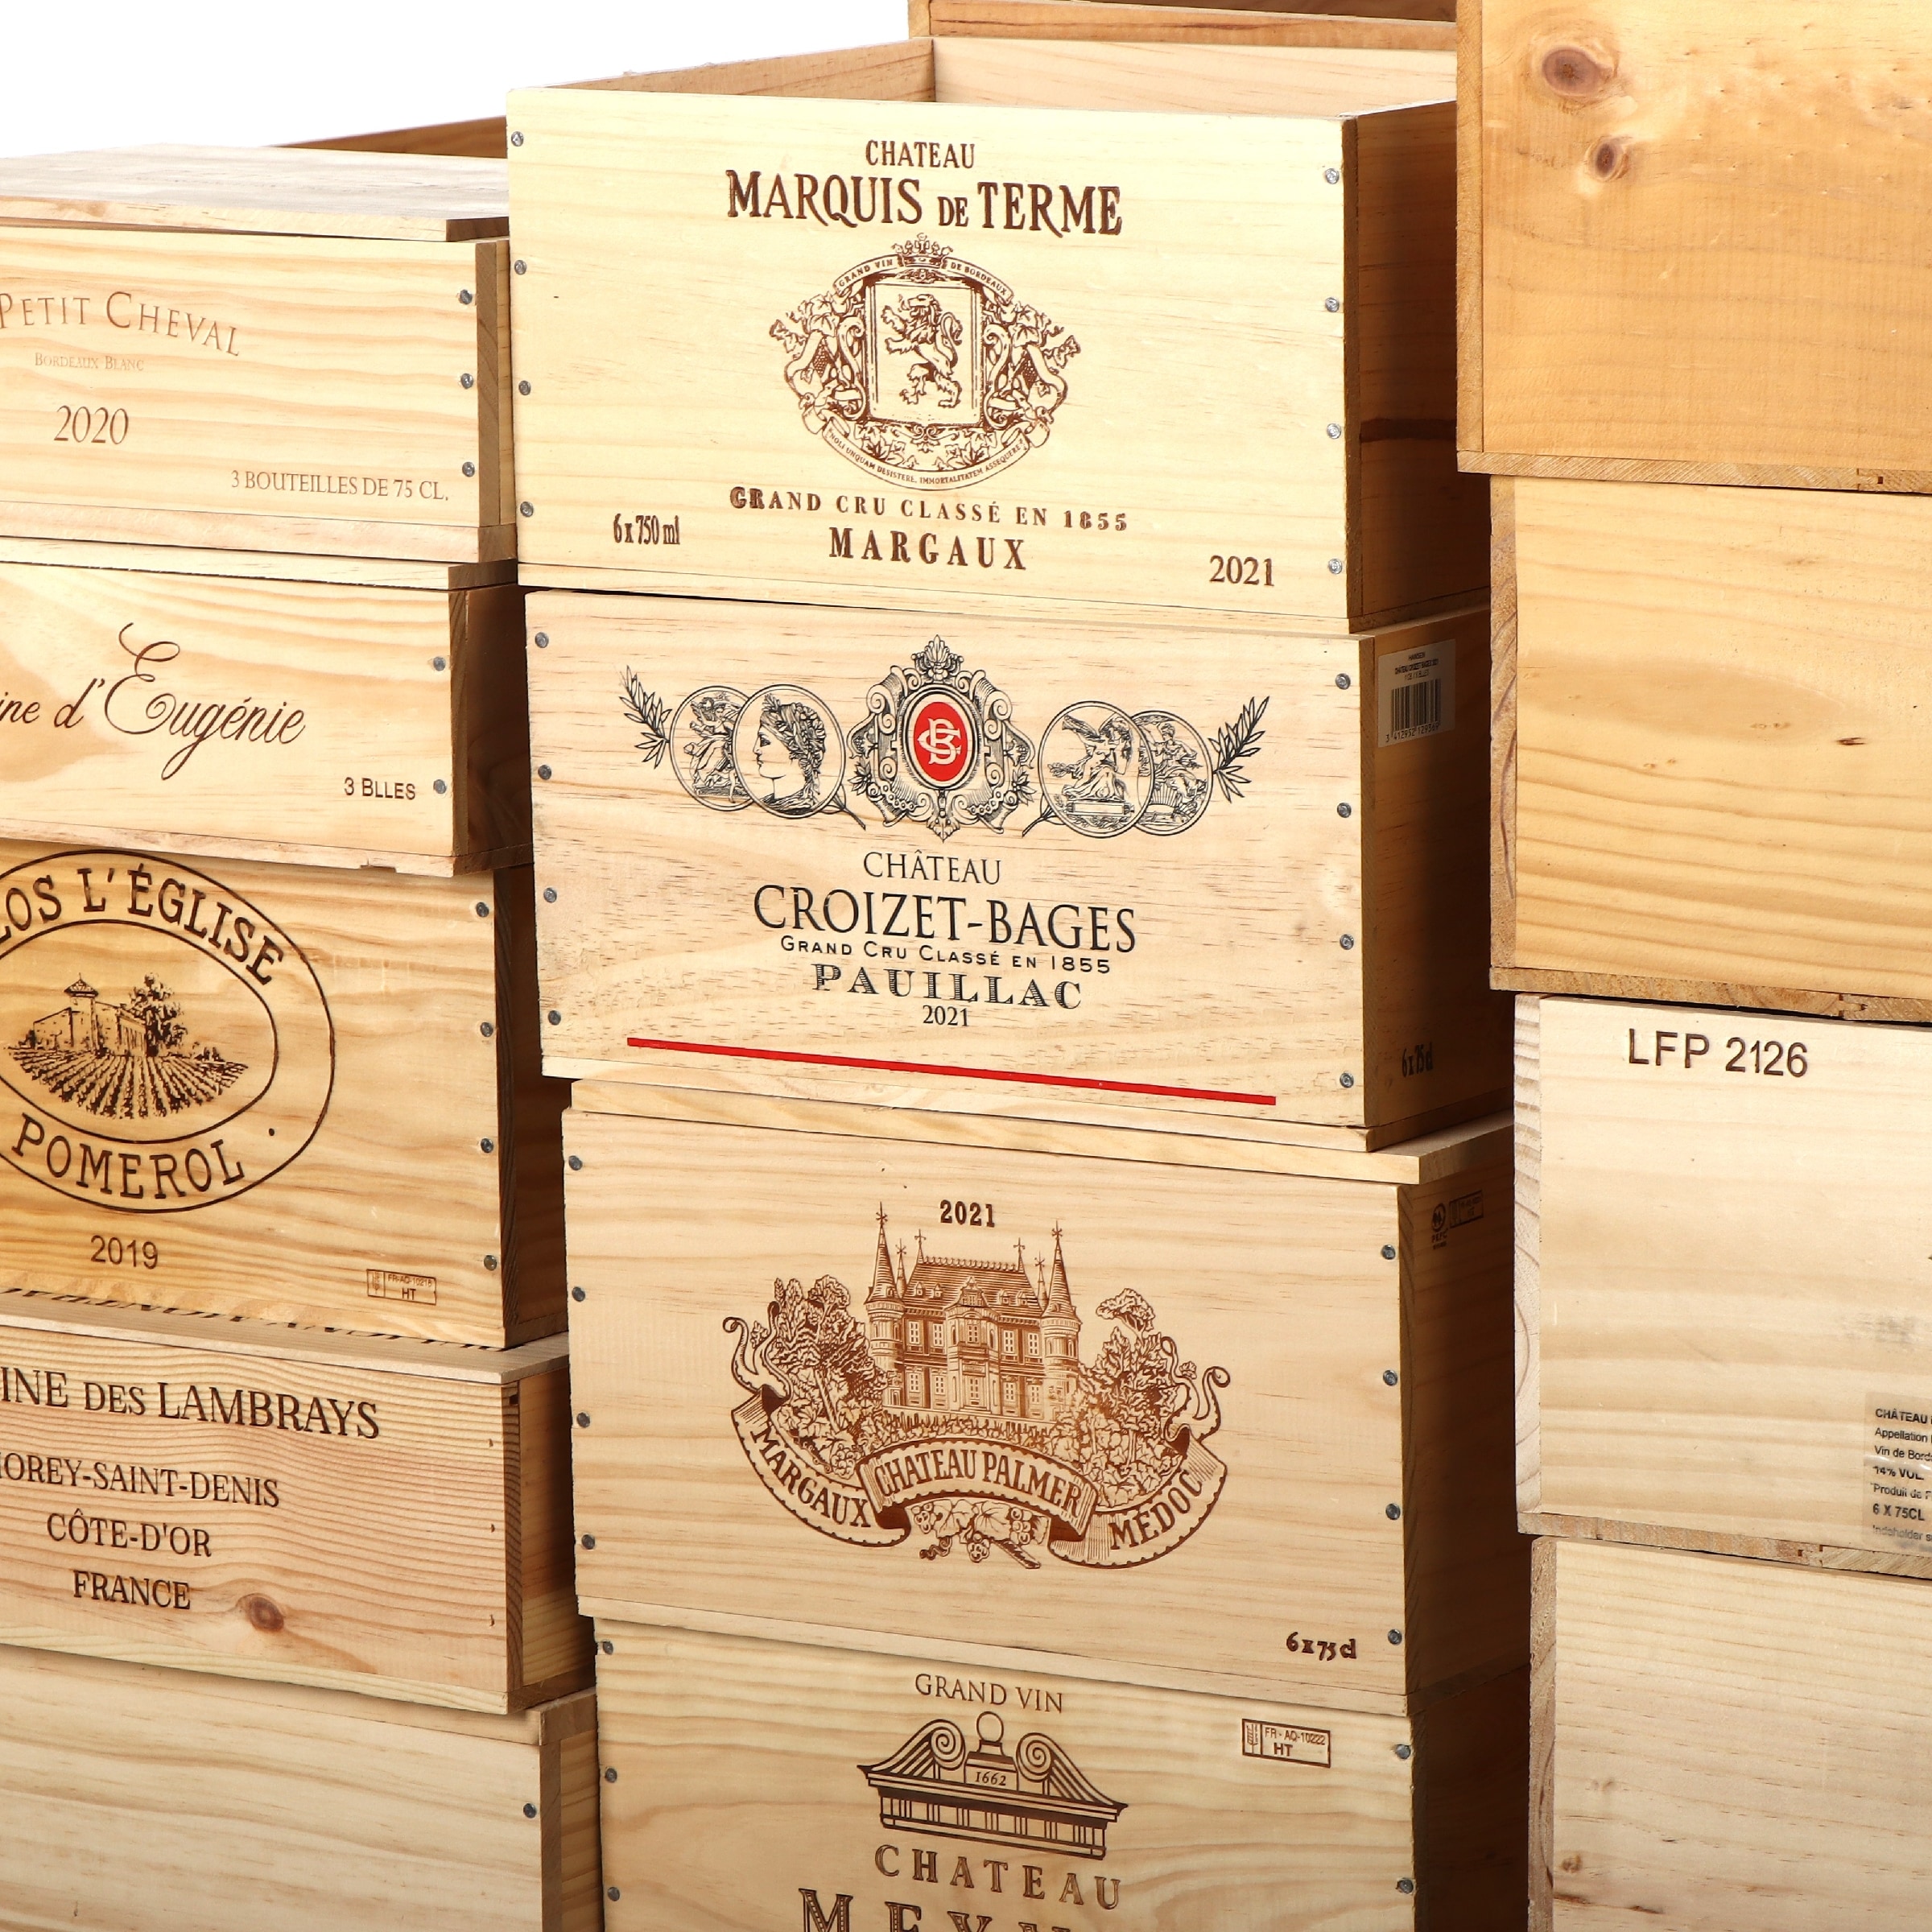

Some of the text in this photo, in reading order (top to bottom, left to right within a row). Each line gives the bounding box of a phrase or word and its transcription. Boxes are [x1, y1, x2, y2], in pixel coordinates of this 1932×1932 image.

[865, 139, 976, 169] CHATEAU
[725, 170, 1123, 238] MARQUIS DE TERME
[839, 258, 1008, 296] GRAND VIN DE BORDEAUX
[0, 291, 239, 357] PETIT CHEVAL
[35, 352, 144, 371] BORDEAUX BLANC
[53, 405, 129, 444] 2020
[231, 469, 239, 488] 3
[245, 471, 357, 495] BOUTEILLES
[362, 477, 388, 497] DE
[393, 479, 412, 498] 75
[729, 486, 1127, 531] GRAND CRU CLASSÉ EN 1855
[830, 526, 1026, 570] MARGAUX
[1209, 555, 1274, 587] 2021
[344, 777, 416, 800] 3 BLLES
[863, 849, 1001, 886] CHÂTEAU
[753, 885, 1136, 954] CROIZET-BAGES
[780, 935, 1110, 975] GRAND CRU CLASSÉ EN 1855
[811, 963, 1082, 1010] PAUILLAC
[922, 1004, 968, 1027] 2021
[1629, 1028, 1808, 1078] LFP 2126
[11, 1113, 245, 1199] POMEROL
[939, 1199, 996, 1228] 2021
[90, 1234, 158, 1269] 2019
[402, 1287, 416, 1300] HT
[84, 1381, 146, 1416] DES
[157, 1381, 380, 1439] LAMBRAYS
[1875, 1408, 1927, 1424] CHÂTEAU
[1874, 1427, 1928, 1443] Appellation
[1874, 1445, 1890, 1455] Vin
[1893, 1448, 1905, 1458] de
[753, 1426, 872, 1528] MARGAUX
[873, 1448, 977, 1500] CHATEAU
[982, 1450, 1084, 1518] PALMER
[1872, 1503, 1926, 1521] 6 X 75CL
[47, 1508, 212, 1558] CÔTE-D'OR
[72, 1570, 191, 1610] FRANCE
[914, 1672, 1063, 1714] GRAND VIN
[1274, 1742, 1293, 1757] HT
[975, 1770, 1007, 1786] 1662
[874, 1843, 1121, 1910] CHATEAU
